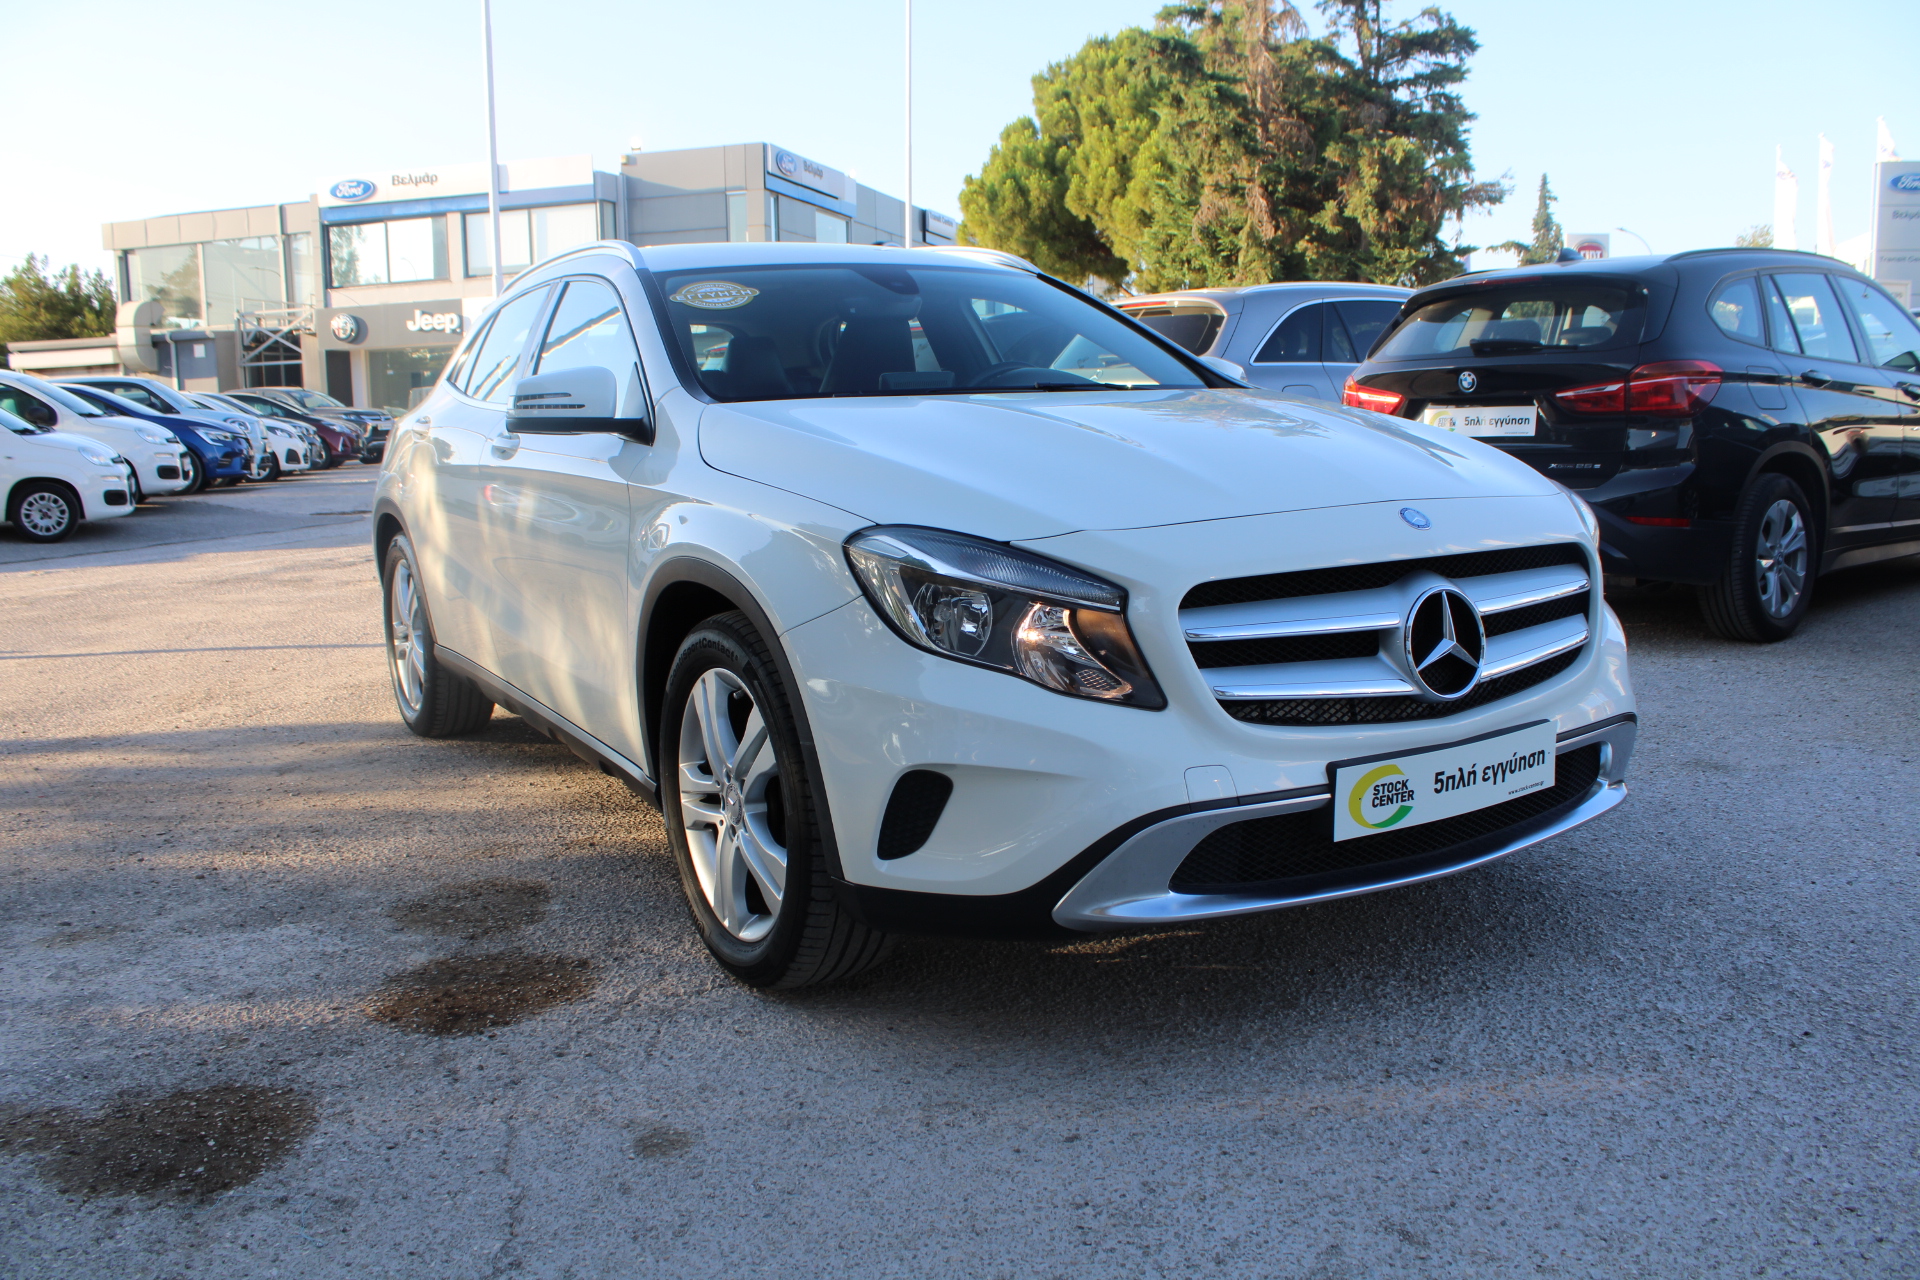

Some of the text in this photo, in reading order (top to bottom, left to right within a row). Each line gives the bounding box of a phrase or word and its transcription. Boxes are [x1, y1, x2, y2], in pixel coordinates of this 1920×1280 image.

[391, 172, 438, 187] Βελμάρ
[336, 181, 365, 198] Ford
[676, 289, 752, 301] ΕΓΓΥΗΣΗ
[406, 309, 459, 333] Jeep
[1489, 415, 1530, 428] εγγύηση
[1433, 749, 1546, 794] 5πλή εγγύηση
[1373, 779, 1409, 796] STOCK
[1372, 790, 1415, 808] CENTER
